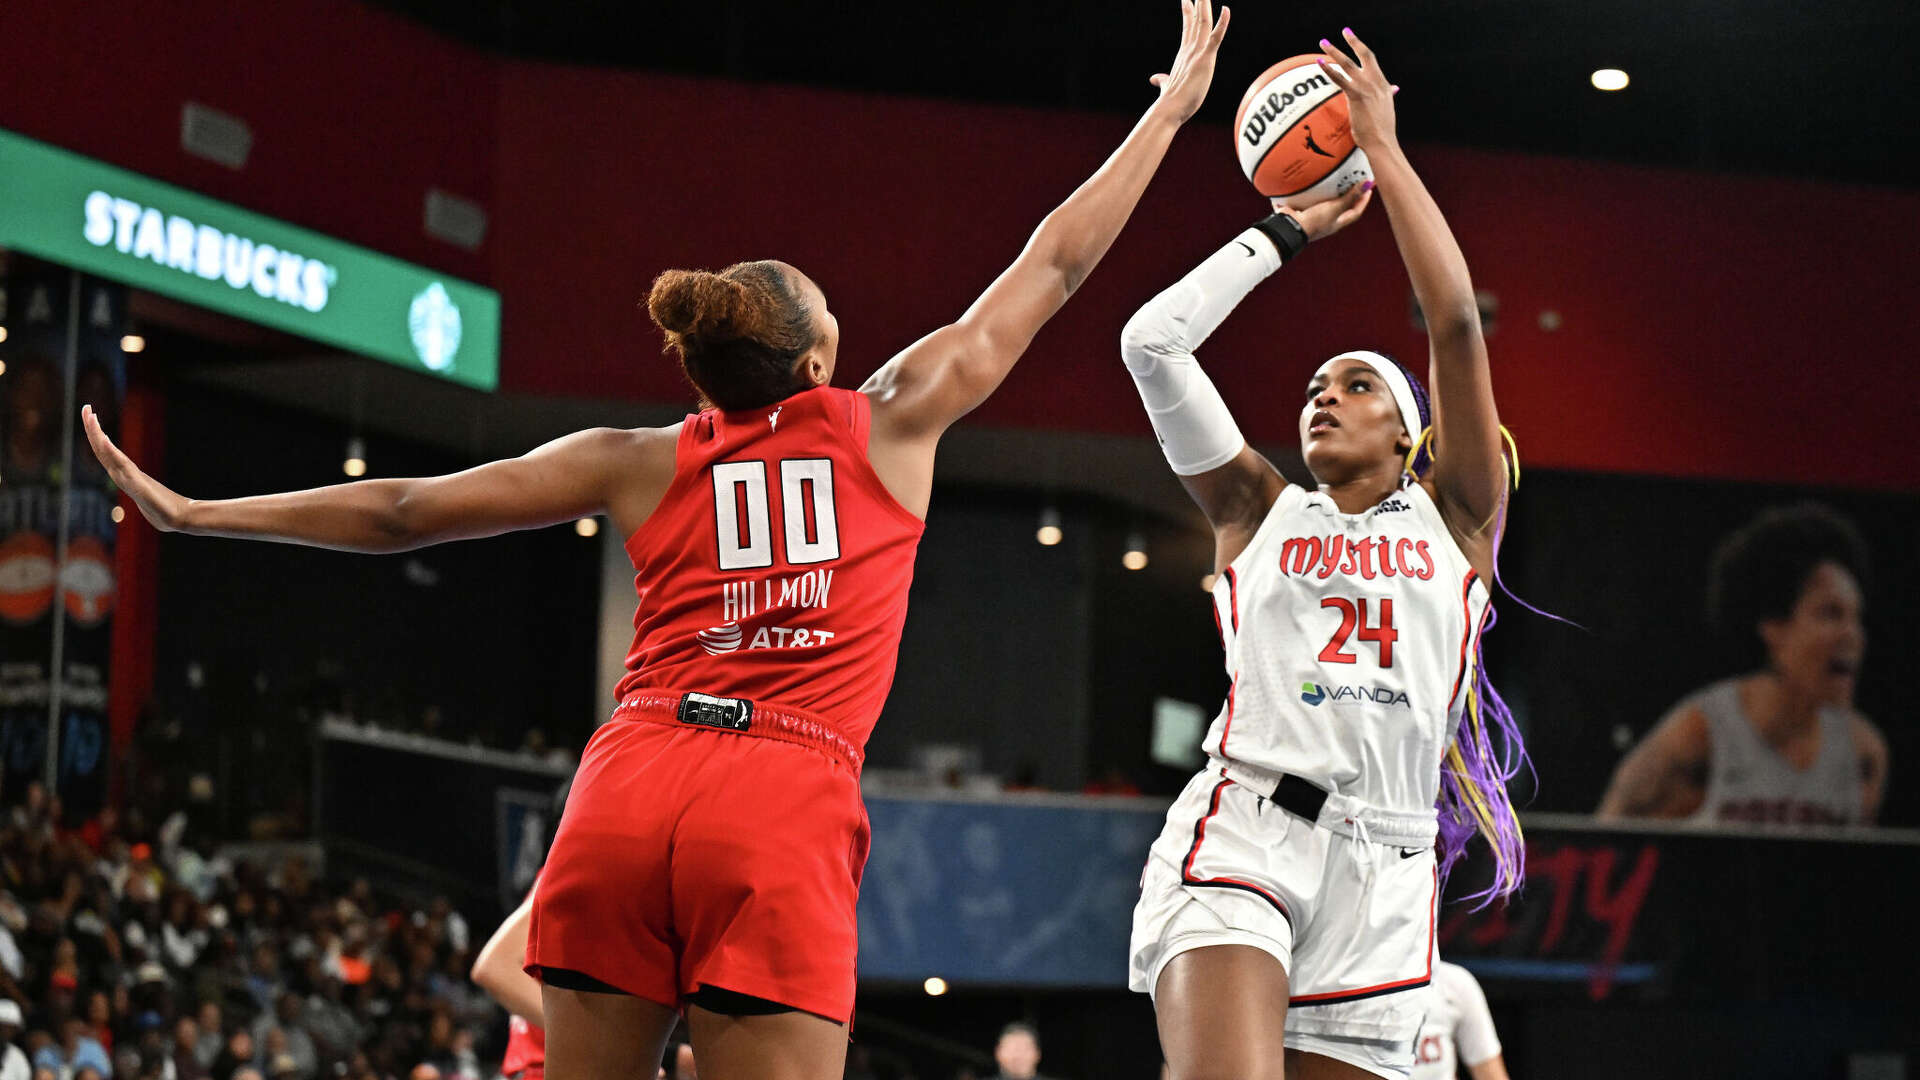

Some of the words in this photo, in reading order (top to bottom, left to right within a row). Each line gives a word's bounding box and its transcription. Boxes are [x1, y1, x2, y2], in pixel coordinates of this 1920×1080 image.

[1243, 74, 1330, 147] Wilson
[84, 190, 331, 313] STARBUCKS
[712, 457, 840, 571] 00
[748, 626, 835, 650] AT&T
[1317, 596, 1399, 669] 24
[1326, 686, 1412, 709] VANDA
